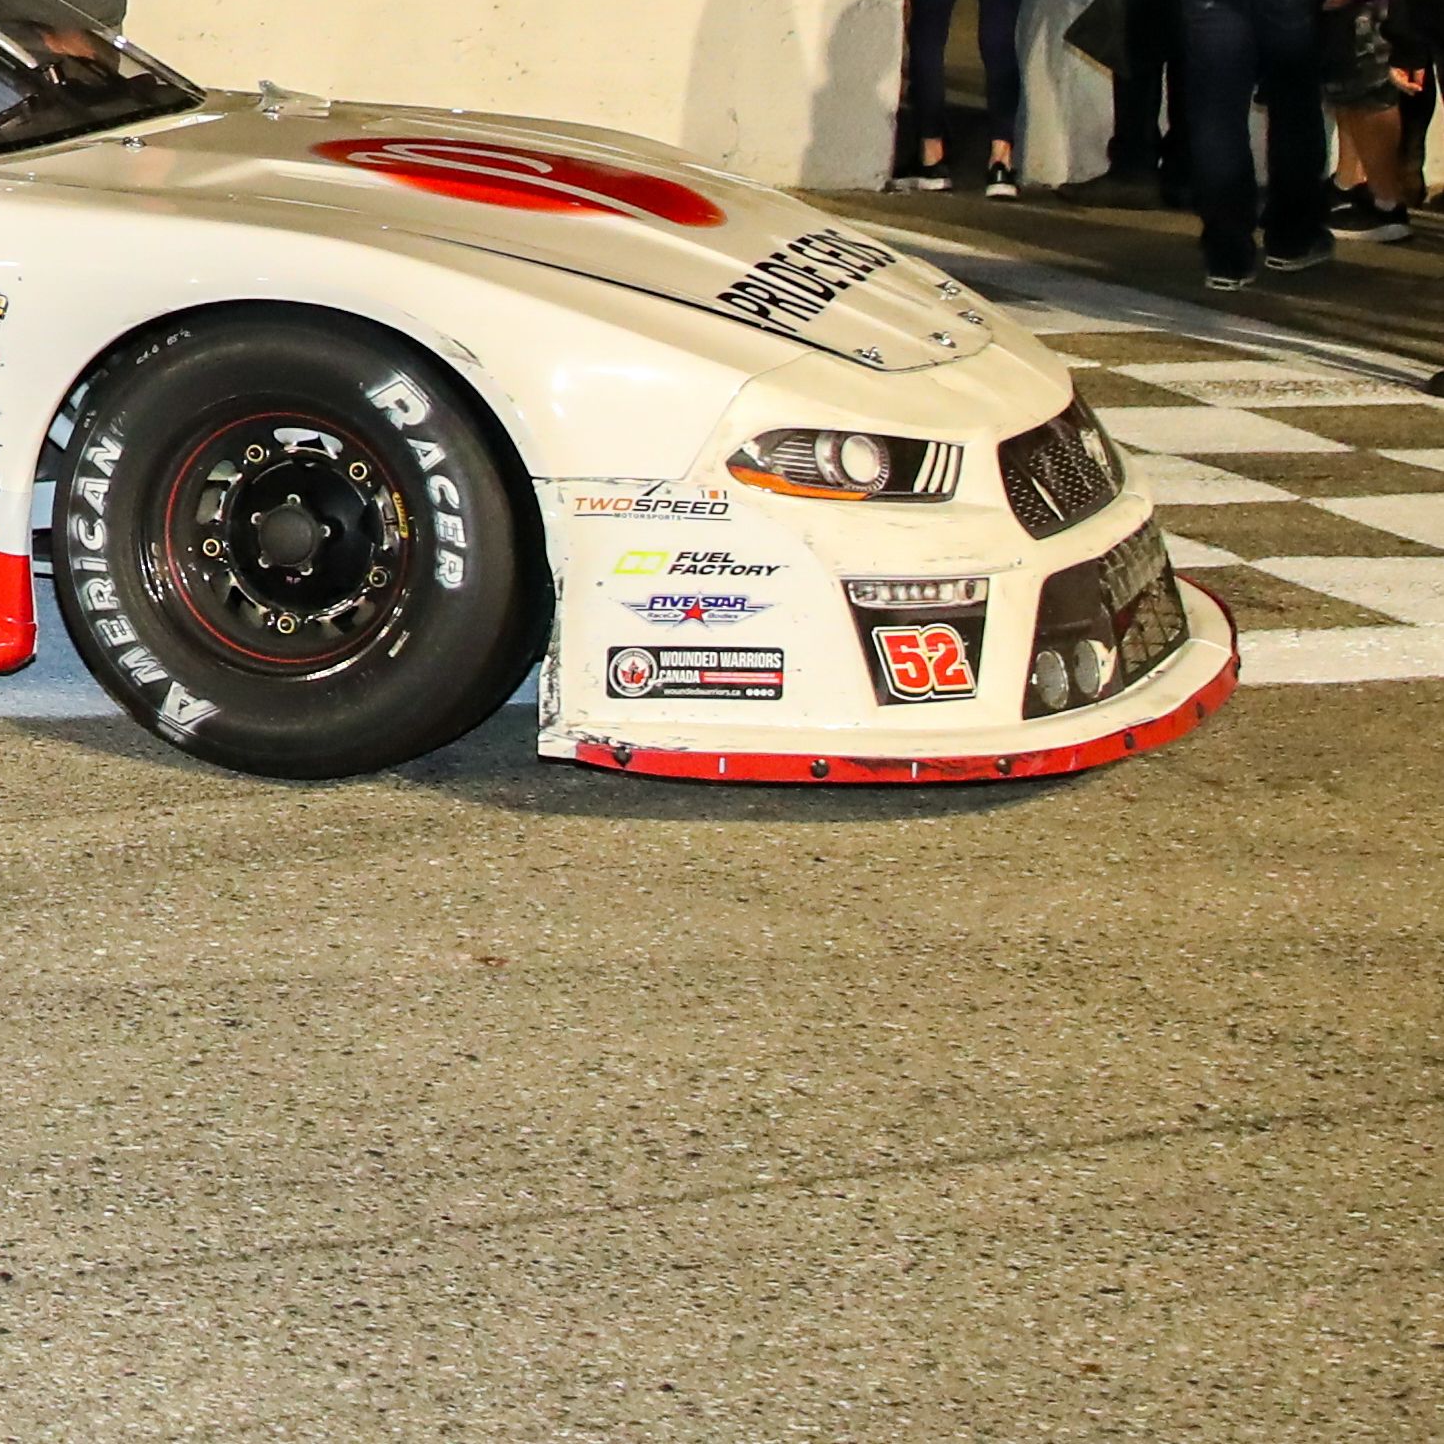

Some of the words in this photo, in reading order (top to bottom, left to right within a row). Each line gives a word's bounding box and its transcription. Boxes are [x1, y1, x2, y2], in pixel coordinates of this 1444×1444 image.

[715, 251, 852, 333] PRIDE
[365, 368, 470, 592] RACER
[613, 512, 682, 521] MOTORSPORTS
[675, 552, 735, 563] FUEL
[667, 564, 781, 576] FACTORY
[69, 434, 220, 738] AMERICAN
[648, 596, 694, 610] FIVE
[700, 597, 747, 610] STAR
[660, 651, 718, 667] WOUNDED
[720, 652, 782, 668] WARRIORS
[881, 628, 970, 694] 52
[659, 670, 700, 683] CANADA
